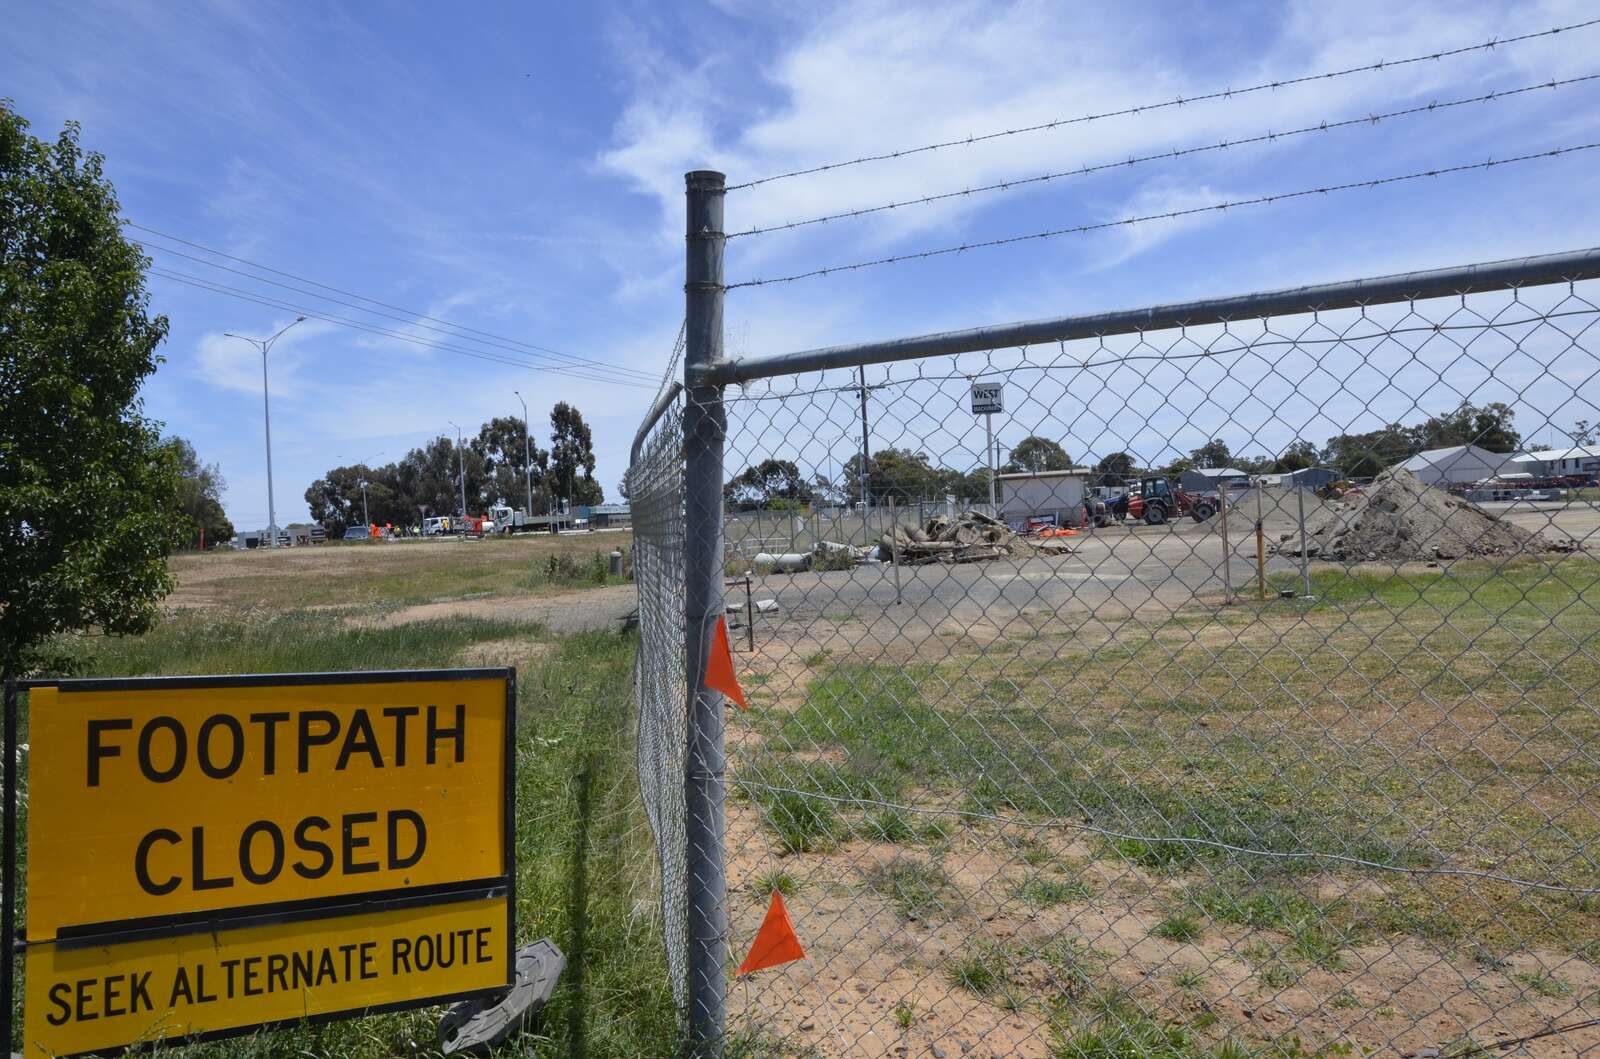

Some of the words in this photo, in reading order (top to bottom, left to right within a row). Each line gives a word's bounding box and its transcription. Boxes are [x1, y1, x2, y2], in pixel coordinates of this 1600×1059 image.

[87, 704, 466, 787] FOOTPATH
[135, 809, 427, 895] CLOSED
[46, 971, 154, 1026] SEEK
[169, 942, 378, 1007] ALTERNATE
[392, 927, 493, 975] ROUTE
